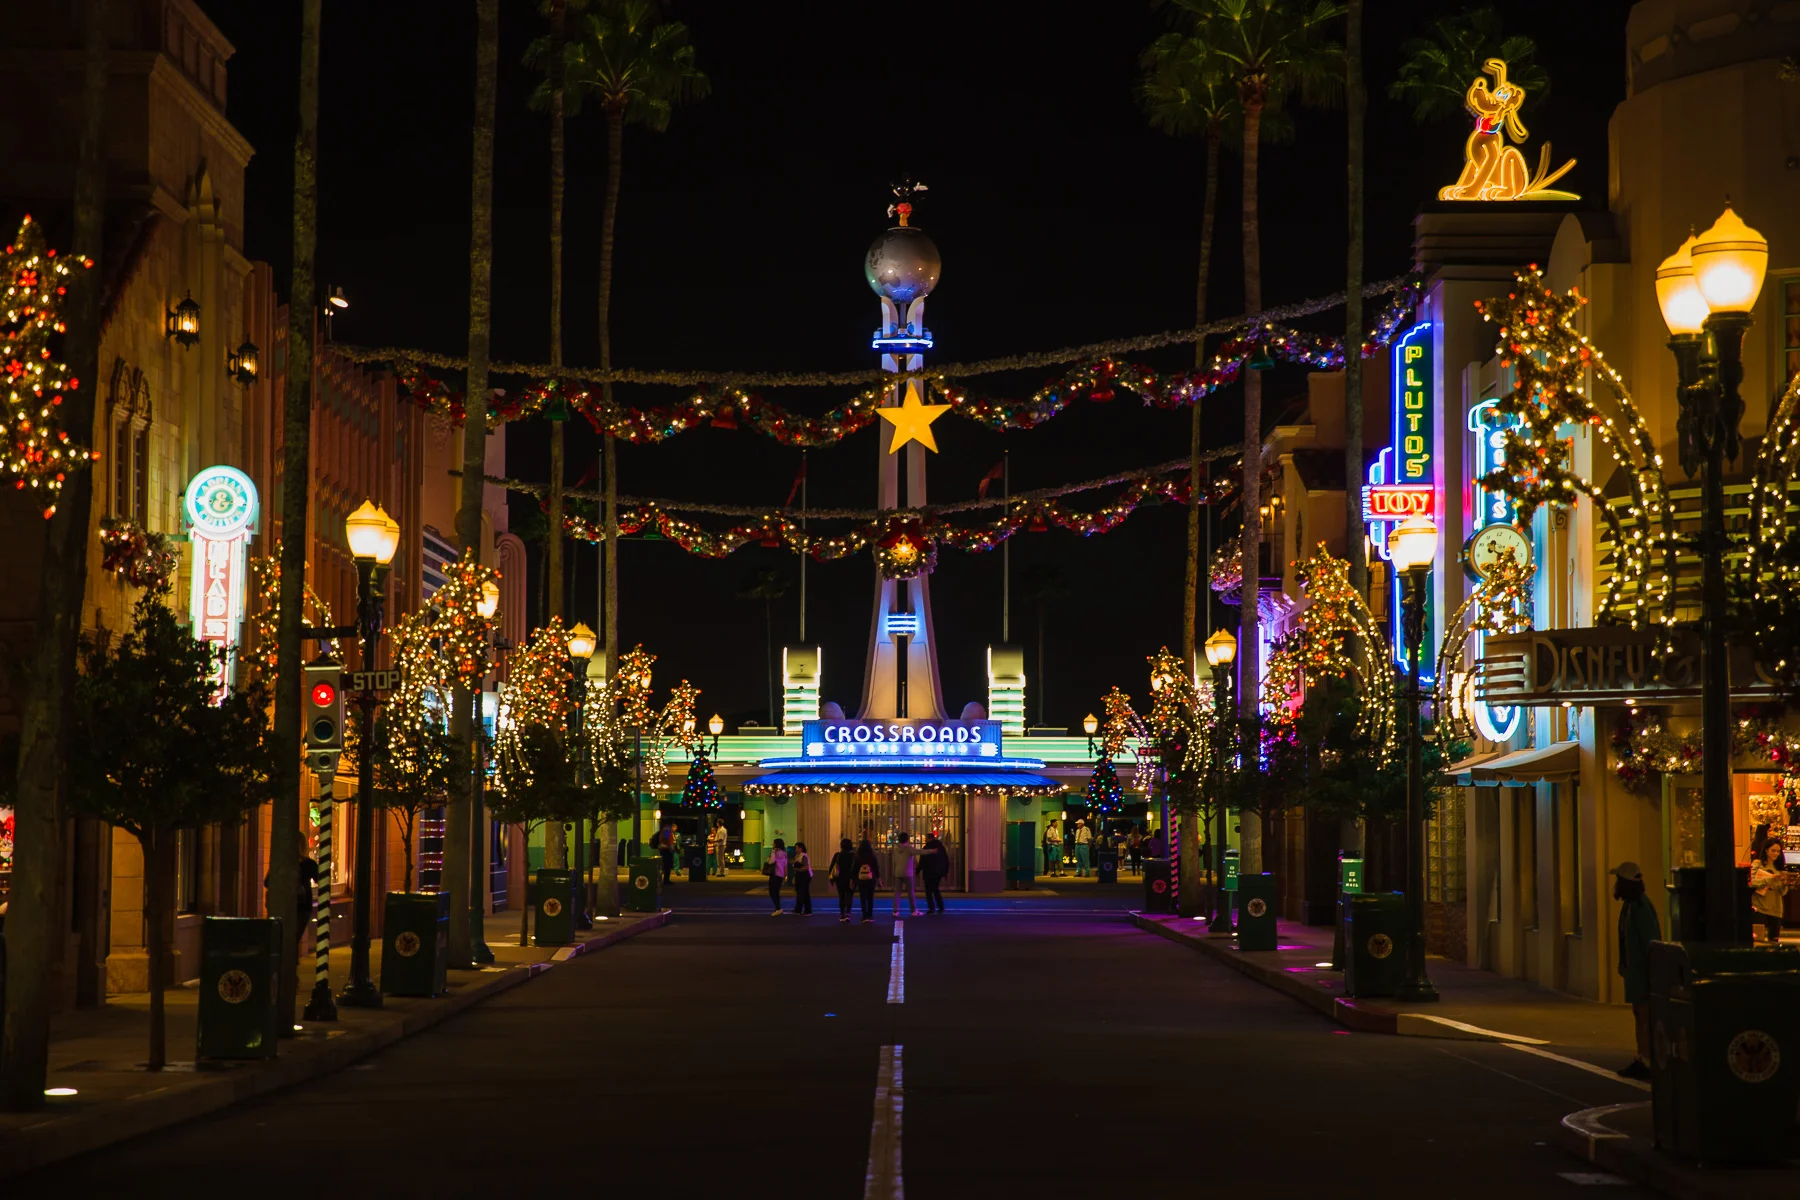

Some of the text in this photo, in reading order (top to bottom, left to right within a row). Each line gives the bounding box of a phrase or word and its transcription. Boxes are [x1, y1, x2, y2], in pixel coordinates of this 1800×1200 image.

[1405, 345, 1430, 478] PLUTO'S
[212, 491, 230, 511] &
[1372, 492, 1430, 513] TOY
[353, 670, 400, 691] STOP
[824, 725, 982, 743] CROSSROADS
